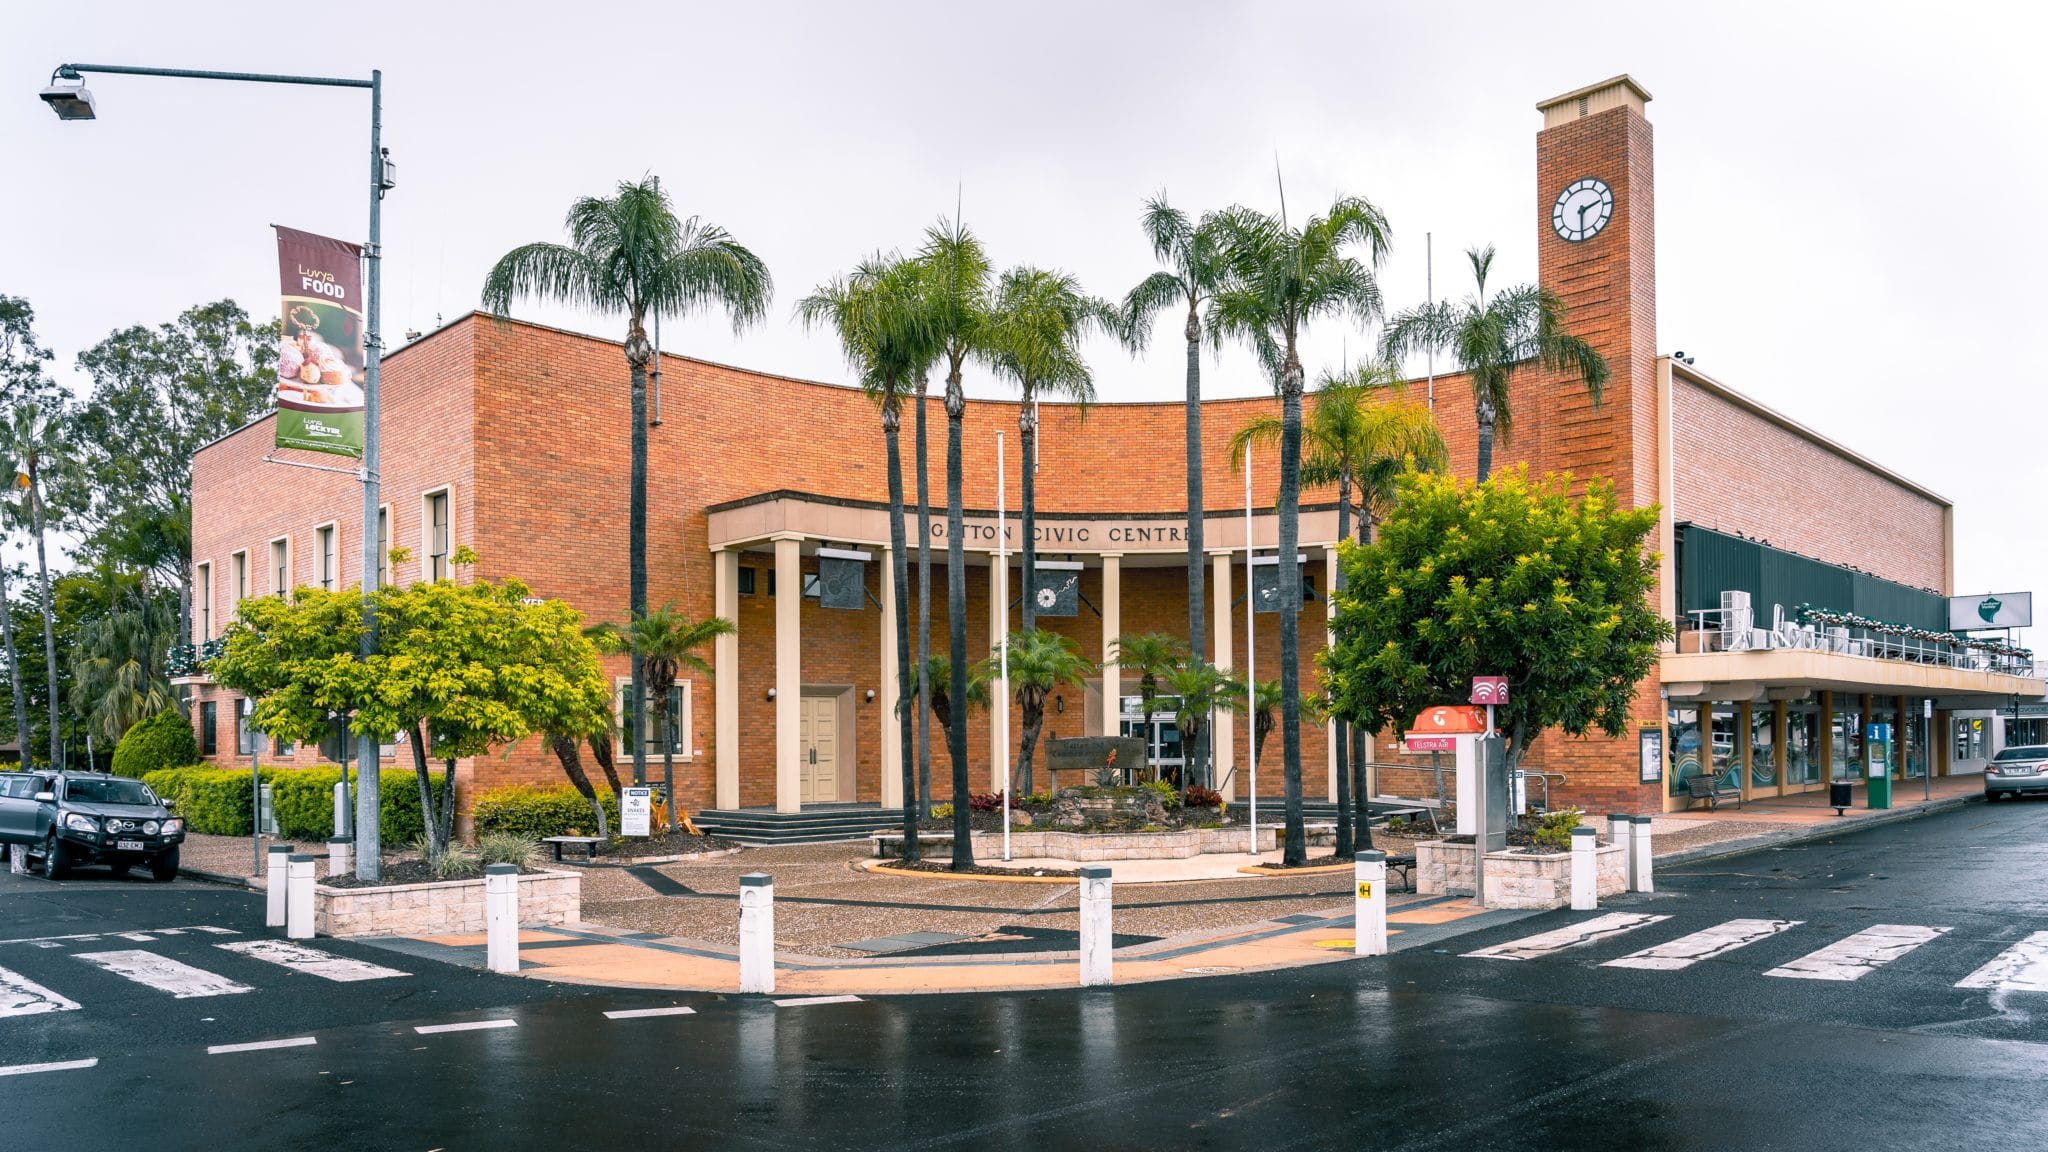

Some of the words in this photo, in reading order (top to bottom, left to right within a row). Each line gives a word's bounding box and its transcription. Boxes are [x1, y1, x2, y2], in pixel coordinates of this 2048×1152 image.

[298, 263, 335, 284] Luvya
[302, 276, 345, 299] FOOD
[931, 523, 1012, 541] GTTON
[1108, 527, 1189, 542] CENTR
